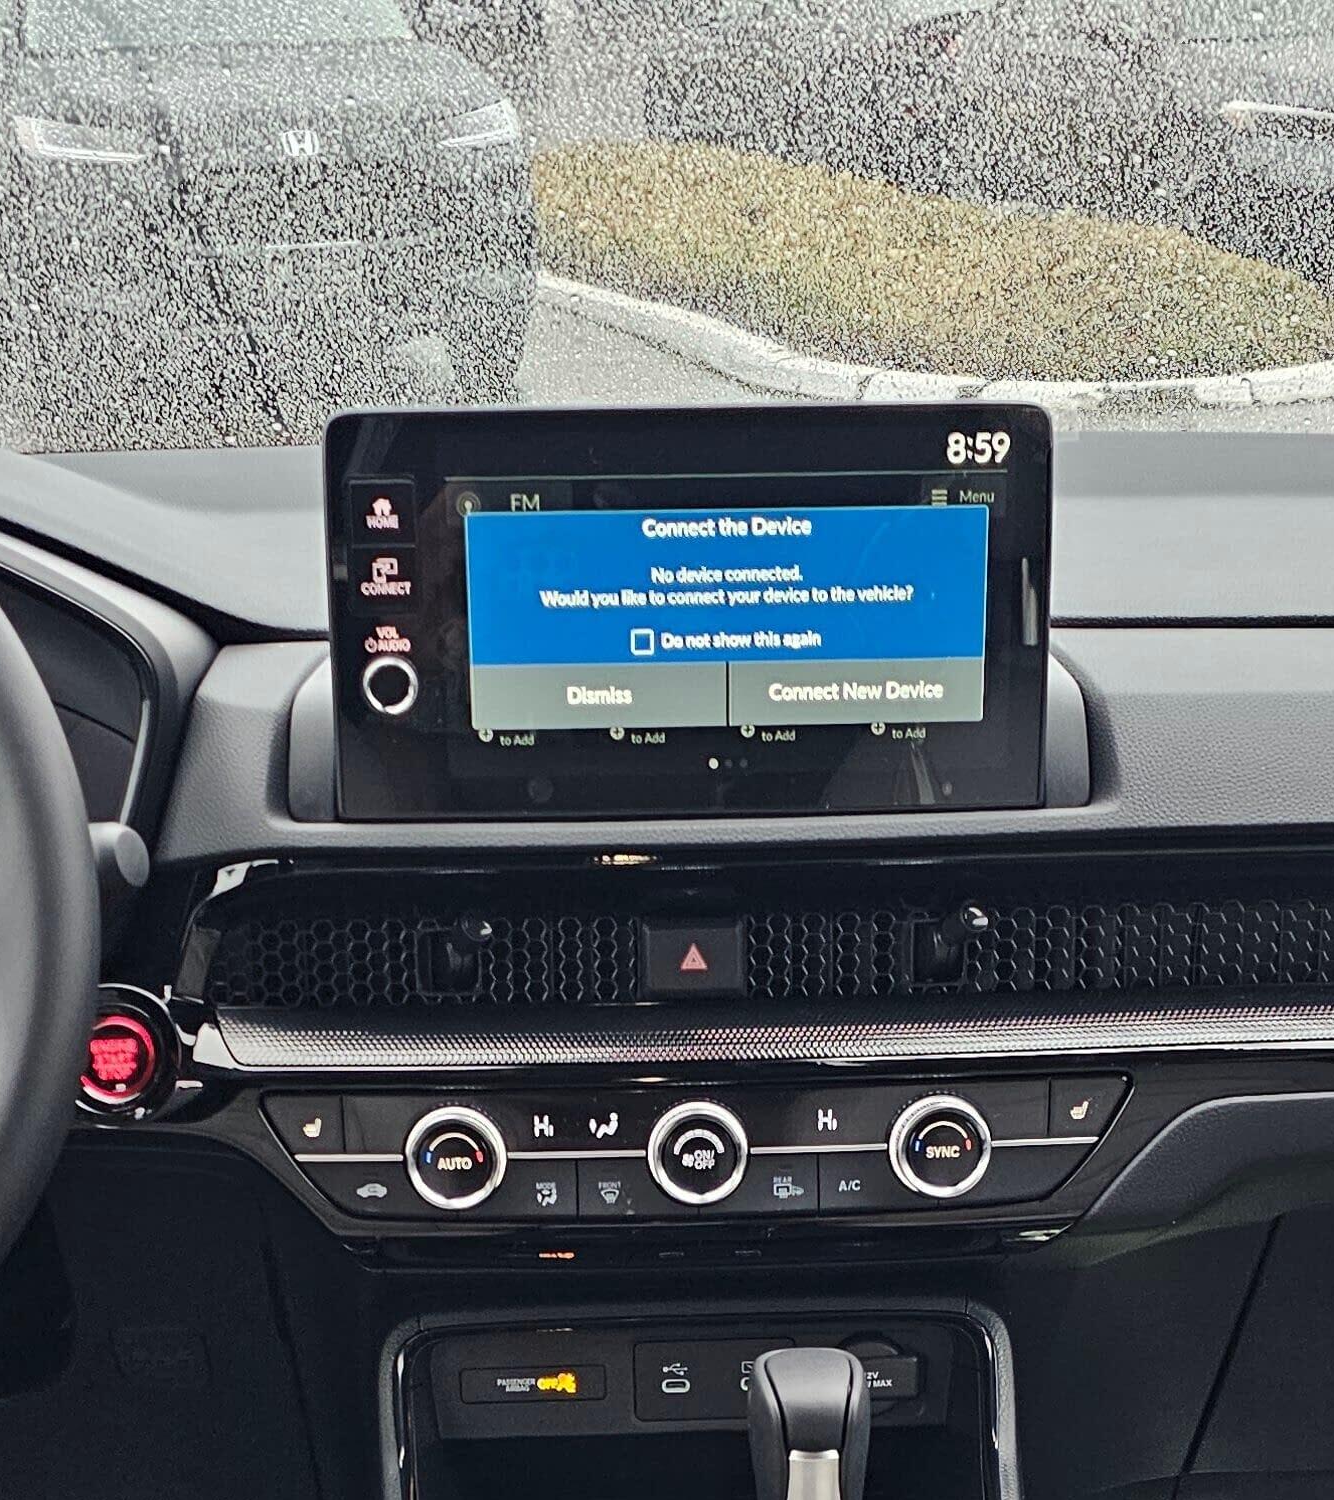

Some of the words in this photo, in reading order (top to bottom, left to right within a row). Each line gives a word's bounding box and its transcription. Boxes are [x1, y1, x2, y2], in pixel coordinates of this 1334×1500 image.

[946, 431, 1011, 465] 8:59
[510, 493, 541, 511] FM
[959, 490, 994, 503] Menu
[366, 514, 399, 529] HOME
[641, 518, 716, 538] Connect
[718, 517, 748, 537] the
[751, 516, 812, 536] Device
[651, 566, 674, 584] No
[676, 565, 722, 583] device
[724, 564, 804, 583] connected.
[360, 581, 412, 596] CONNECT
[539, 590, 589, 608] Would
[590, 591, 619, 609] you
[620, 590, 646, 606] like
[648, 589, 667, 606] to
[667, 588, 726, 606] connect
[728, 588, 761, 607] your
[763, 587, 810, 604] device
[811, 586, 828, 602] to
[830, 586, 854, 602] the
[857, 584, 915, 602] vehicle?
[375, 626, 400, 639] VOL
[661, 632, 684, 649] Do
[685, 633, 712, 649] not
[712, 631, 752, 648] show
[753, 630, 781, 648] this
[782, 629, 822, 649] again
[378, 638, 412, 653] AUDIO
[567, 686, 633, 705] Dismiss
[768, 683, 839, 702] Connect
[842, 682, 884, 701] New
[885, 680, 945, 700] Device
[631, 732, 643, 745] to
[644, 732, 666, 745] Add
[761, 730, 773, 743] to
[774, 730, 796, 743] Add
[891, 727, 904, 740] to
[905, 727, 927, 740] Add
[499, 734, 511, 747] to
[513, 734, 535, 747] Add
[694, 1149, 716, 1160] ON/
[925, 1146, 960, 1159] SYNC
[437, 1157, 473, 1171] AUTO
[694, 1158, 716, 1170] OFF
[535, 1182, 556, 1190] MODE
[598, 1181, 622, 1189] FRONT
[773, 1176, 793, 1184] REAR
[838, 1180, 861, 1193] A/C
[872, 1379, 893, 1388] MAX
